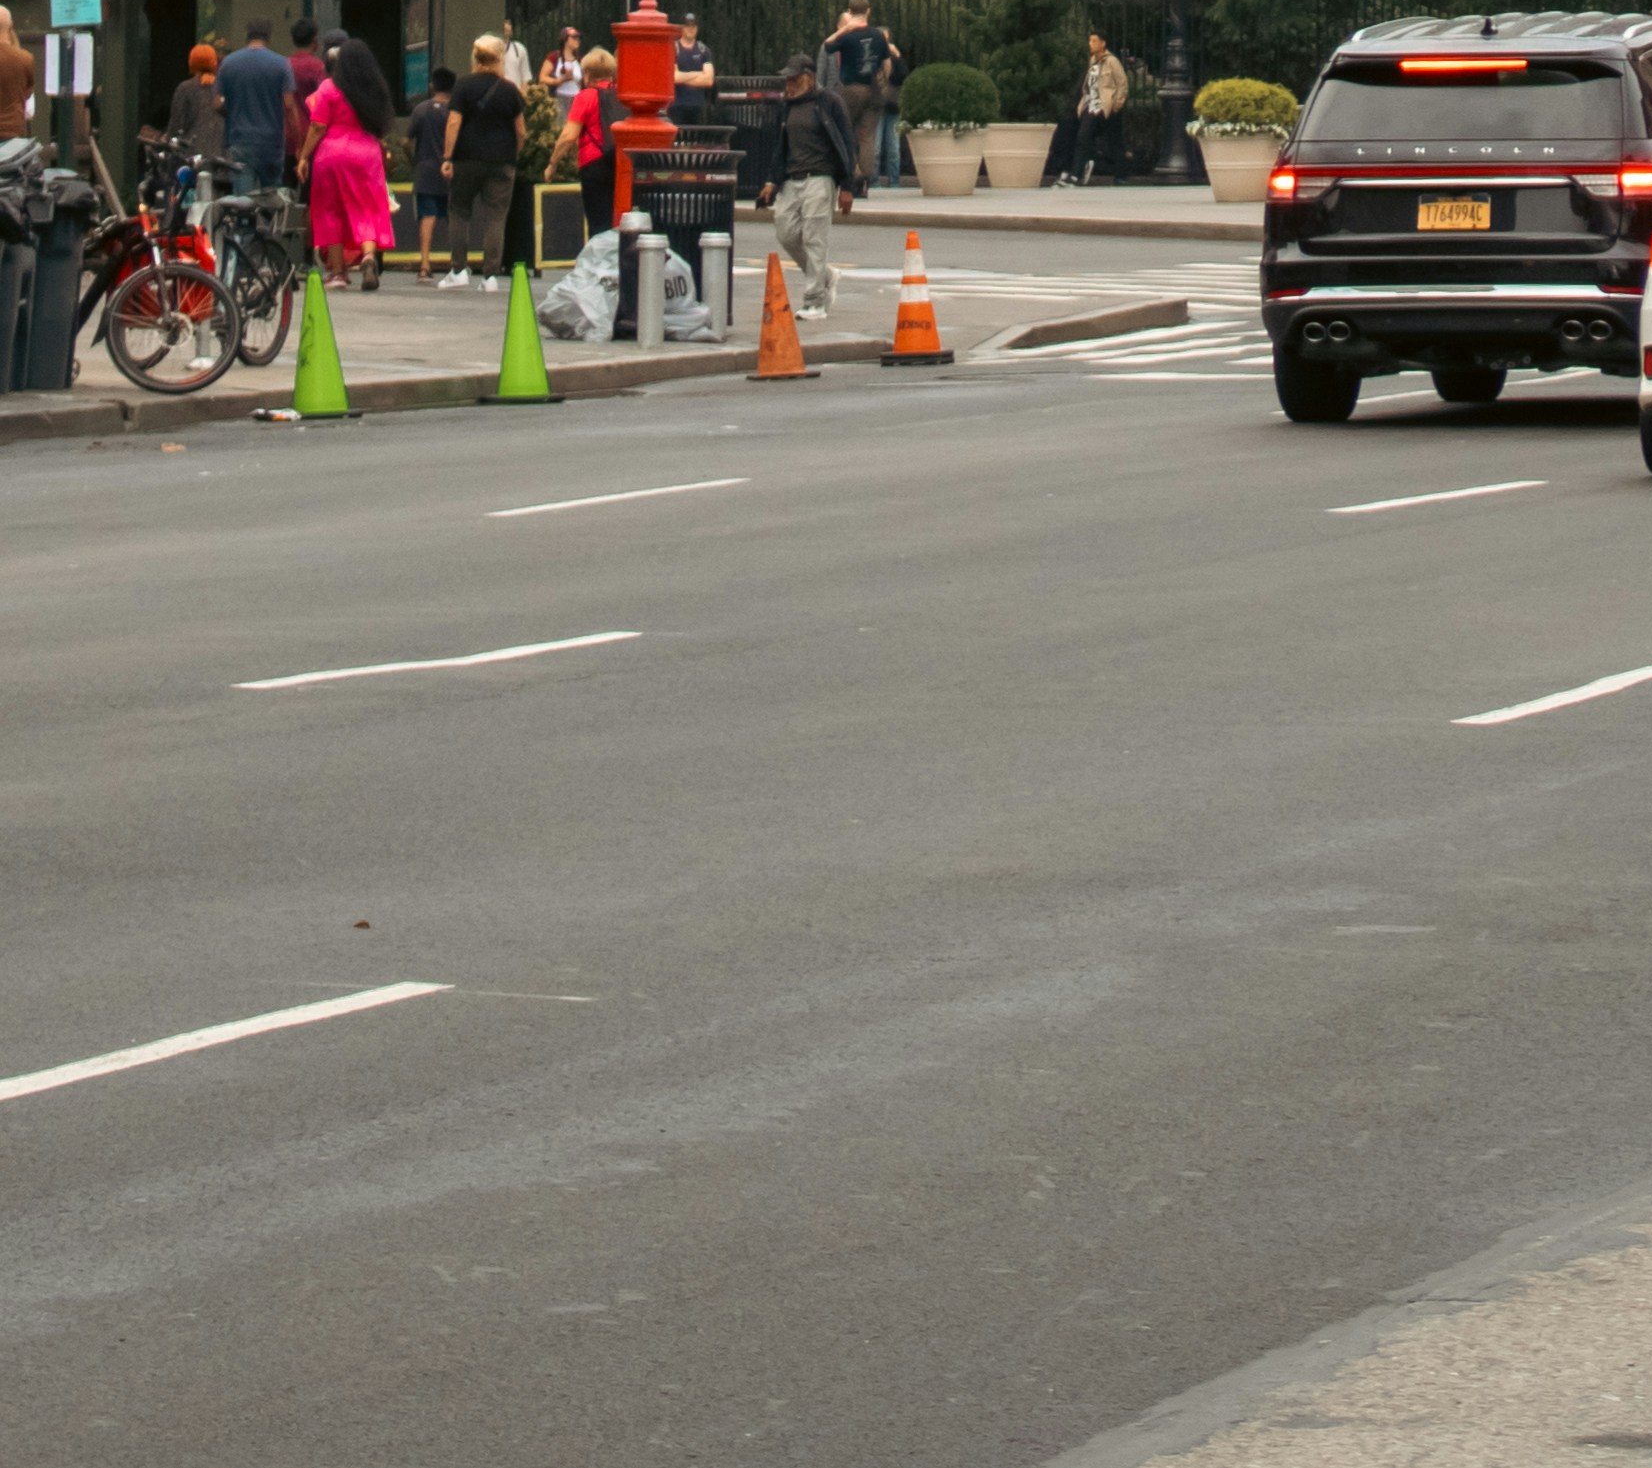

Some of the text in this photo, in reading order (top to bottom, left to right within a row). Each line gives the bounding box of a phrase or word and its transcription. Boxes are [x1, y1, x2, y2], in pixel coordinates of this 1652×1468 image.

[1356, 146, 1555, 156] LINCOLN
[1425, 204, 1483, 223] T764994C
[664, 275, 687, 300] BID
